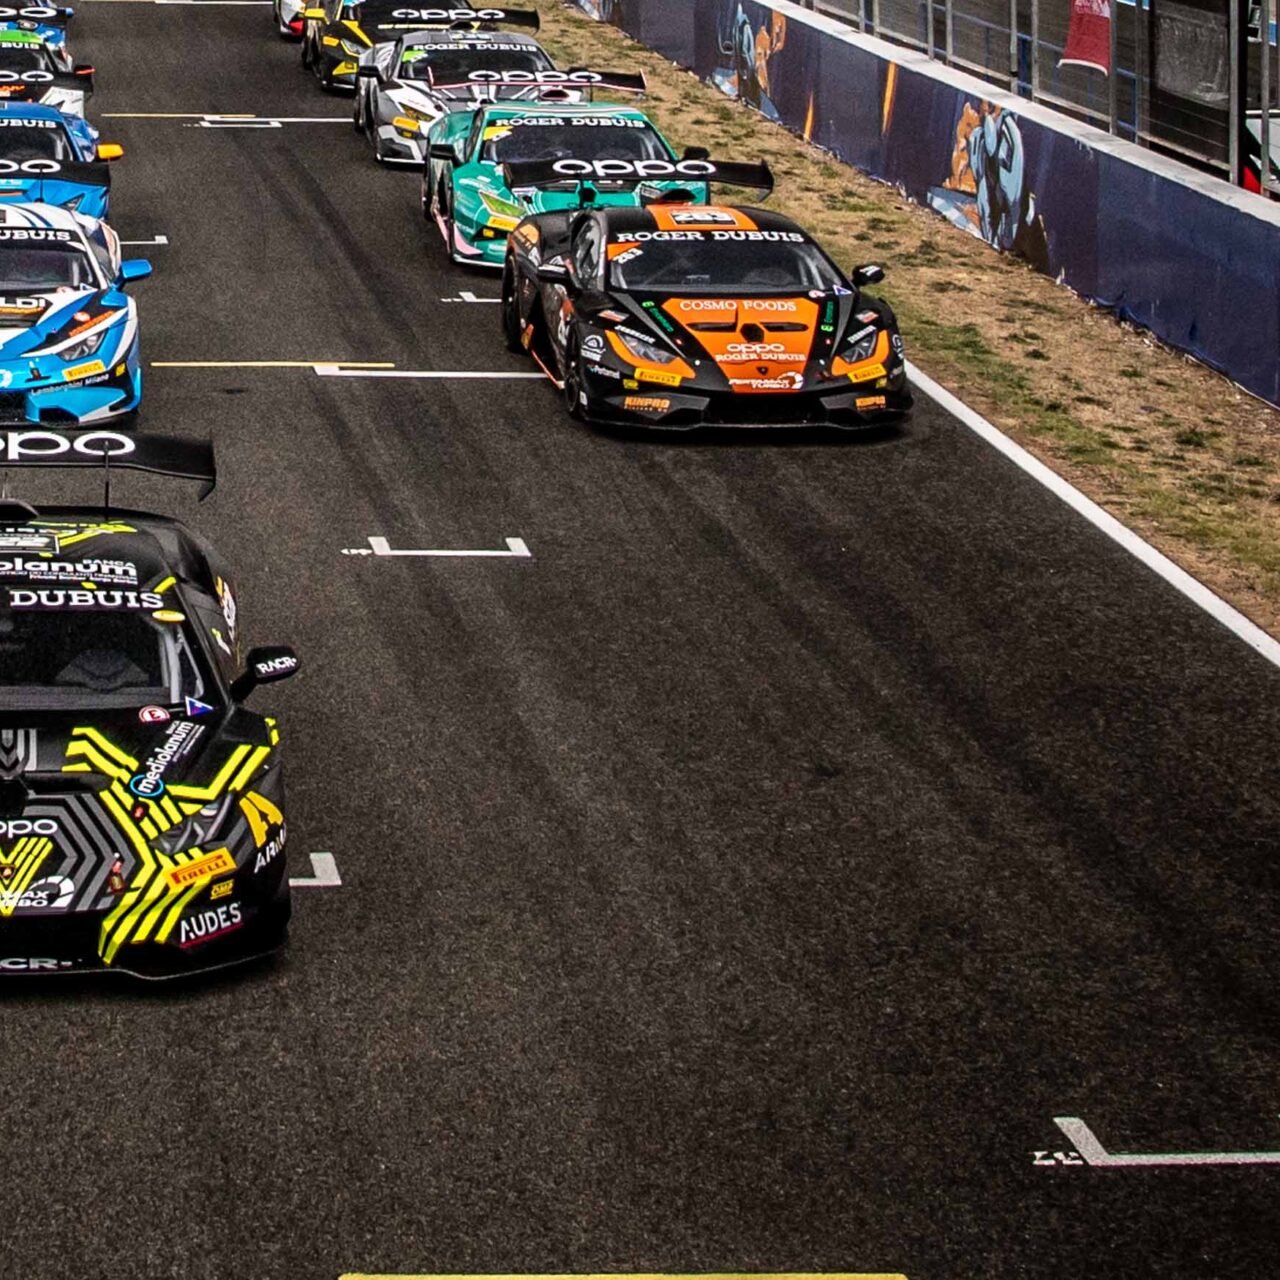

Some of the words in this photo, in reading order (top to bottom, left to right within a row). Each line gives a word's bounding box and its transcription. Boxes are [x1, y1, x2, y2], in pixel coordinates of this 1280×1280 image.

[392, 8, 505, 20] oppo
[476, 44, 537, 52] DUBUIS
[468, 70, 602, 82] oppo
[496, 118, 565, 127] ROGER
[571, 117, 645, 128] DUBUIS
[552, 159, 717, 177] oppo
[617, 231, 705, 243] ROGER
[711, 231, 805, 243] DUBUIS
[612, 247, 644, 264] 263
[679, 299, 737, 311] COSMO
[743, 299, 797, 312] FOODS
[726, 343, 785, 354] oppo
[715, 353, 758, 361] ROGER
[761, 353, 806, 361] DUBUIS
[9, 590, 164, 609] DUBUIS
[138, 722, 194, 793] mediolanum
[170, 854, 228, 884] PIRELLI
[180, 902, 242, 943] AUDES
